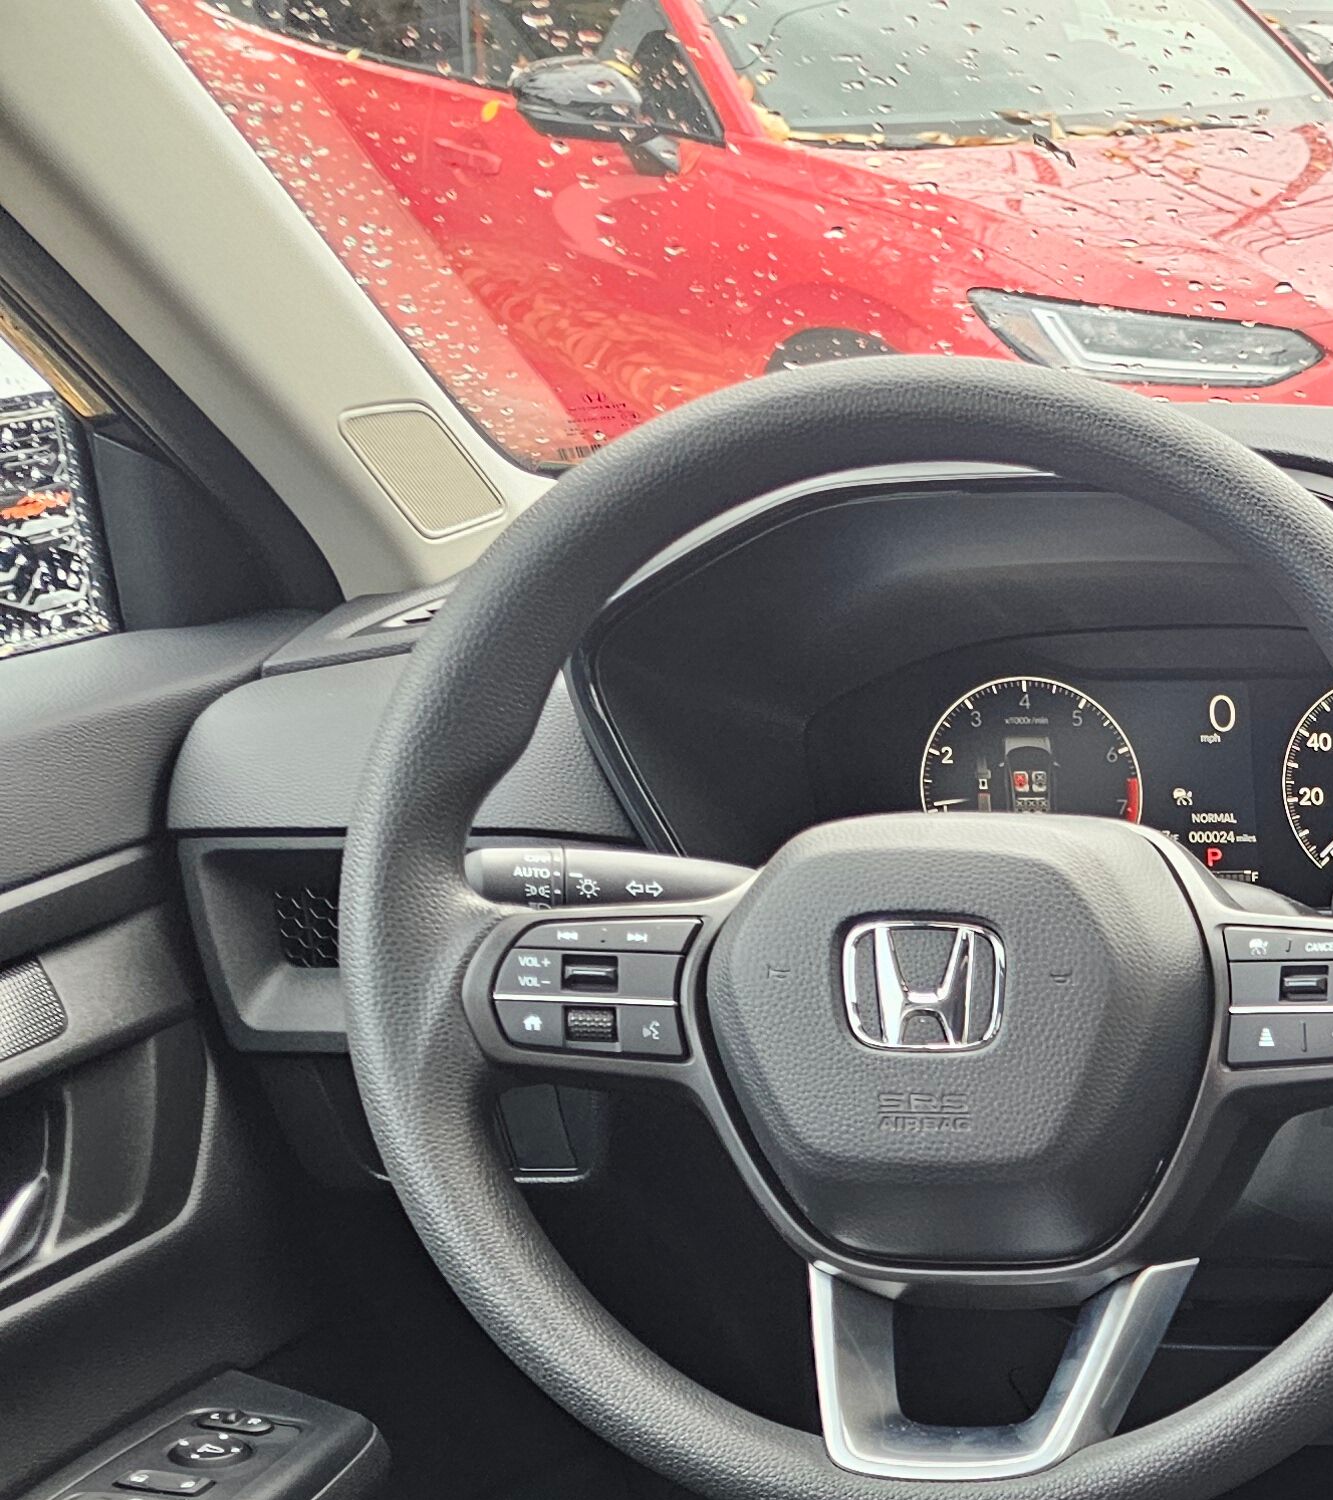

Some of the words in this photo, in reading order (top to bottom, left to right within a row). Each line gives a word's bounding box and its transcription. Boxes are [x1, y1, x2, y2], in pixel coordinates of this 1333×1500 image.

[1018, 694, 1031, 710] 4
[970, 711, 982, 727] 3
[1072, 711, 1083, 726] 5
[1209, 694, 1236, 732] 0
[1200, 734, 1221, 744] mph
[1306, 732, 1332, 752] 40
[941, 746, 954, 764] 2
[1106, 749, 1118, 763] 6
[1298, 787, 1324, 806] 20
[1191, 813, 1238, 824] NORMAL
[1188, 831, 1235, 844] 000024
[1207, 847, 1223, 867] P
[513, 866, 551, 879] AUTO
